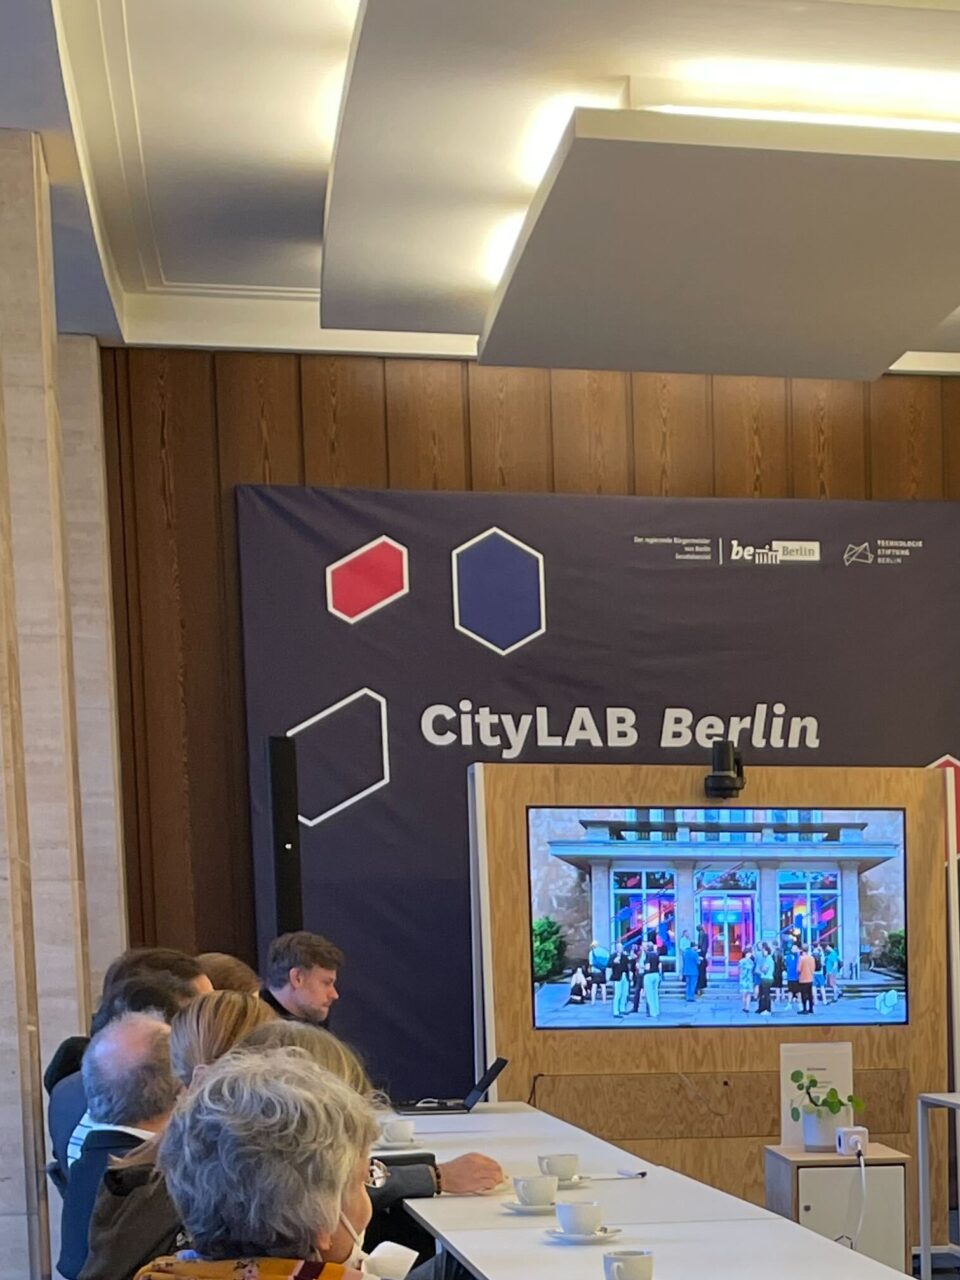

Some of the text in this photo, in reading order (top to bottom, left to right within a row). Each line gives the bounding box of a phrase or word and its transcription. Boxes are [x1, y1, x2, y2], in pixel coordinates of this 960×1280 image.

[782, 546, 815, 557] Berlin
[421, 700, 820, 758] CityLAB Berlin
